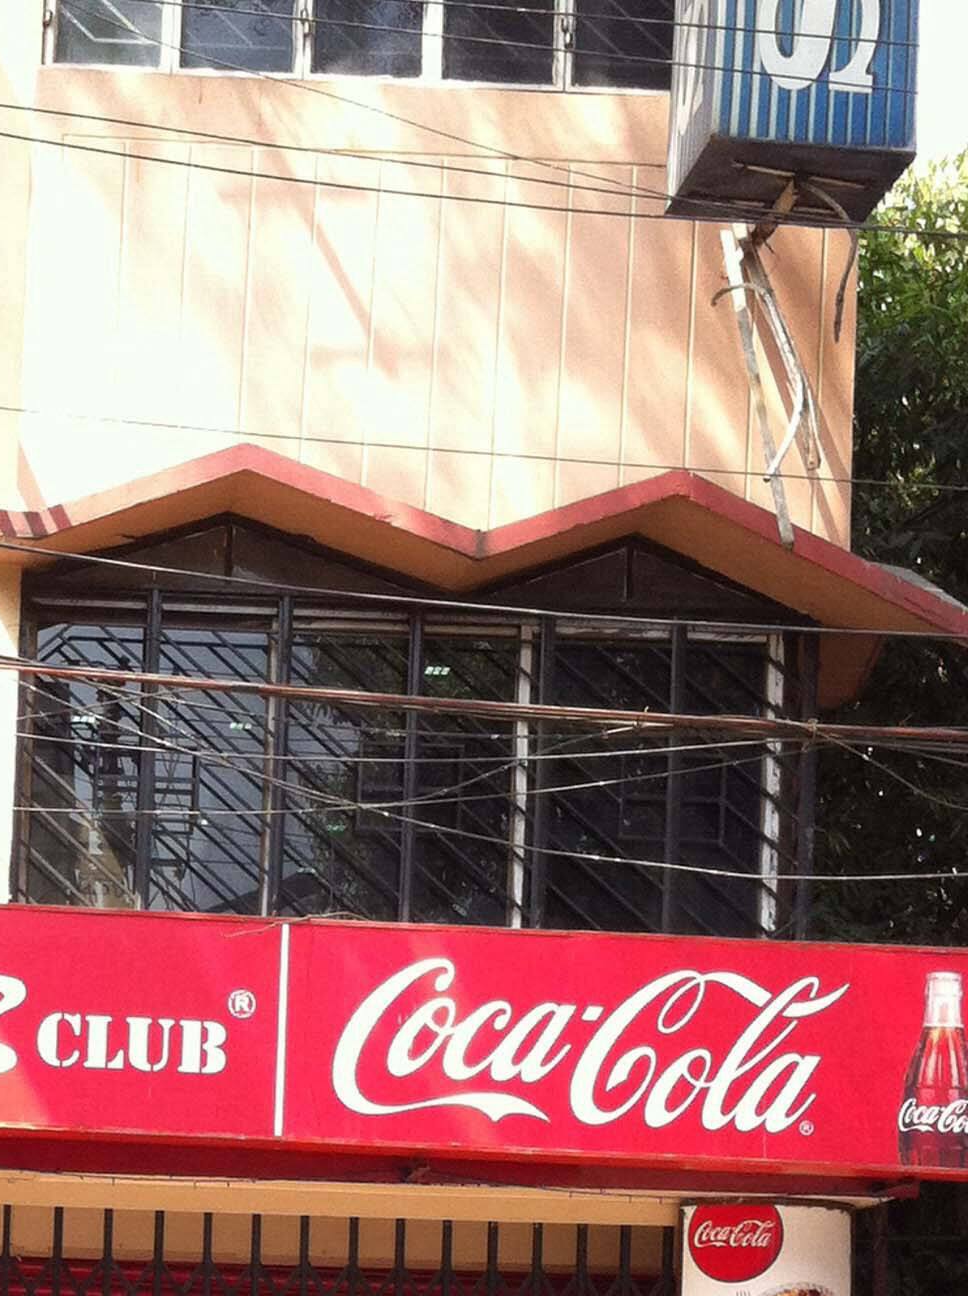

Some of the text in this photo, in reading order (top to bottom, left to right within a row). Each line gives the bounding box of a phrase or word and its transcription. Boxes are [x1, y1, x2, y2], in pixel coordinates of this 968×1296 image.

[37, 1012, 227, 1075] CLUB
[331, 957, 850, 1133] Coca-Cola
[694, 1220, 775, 1248] Coca-Cola
